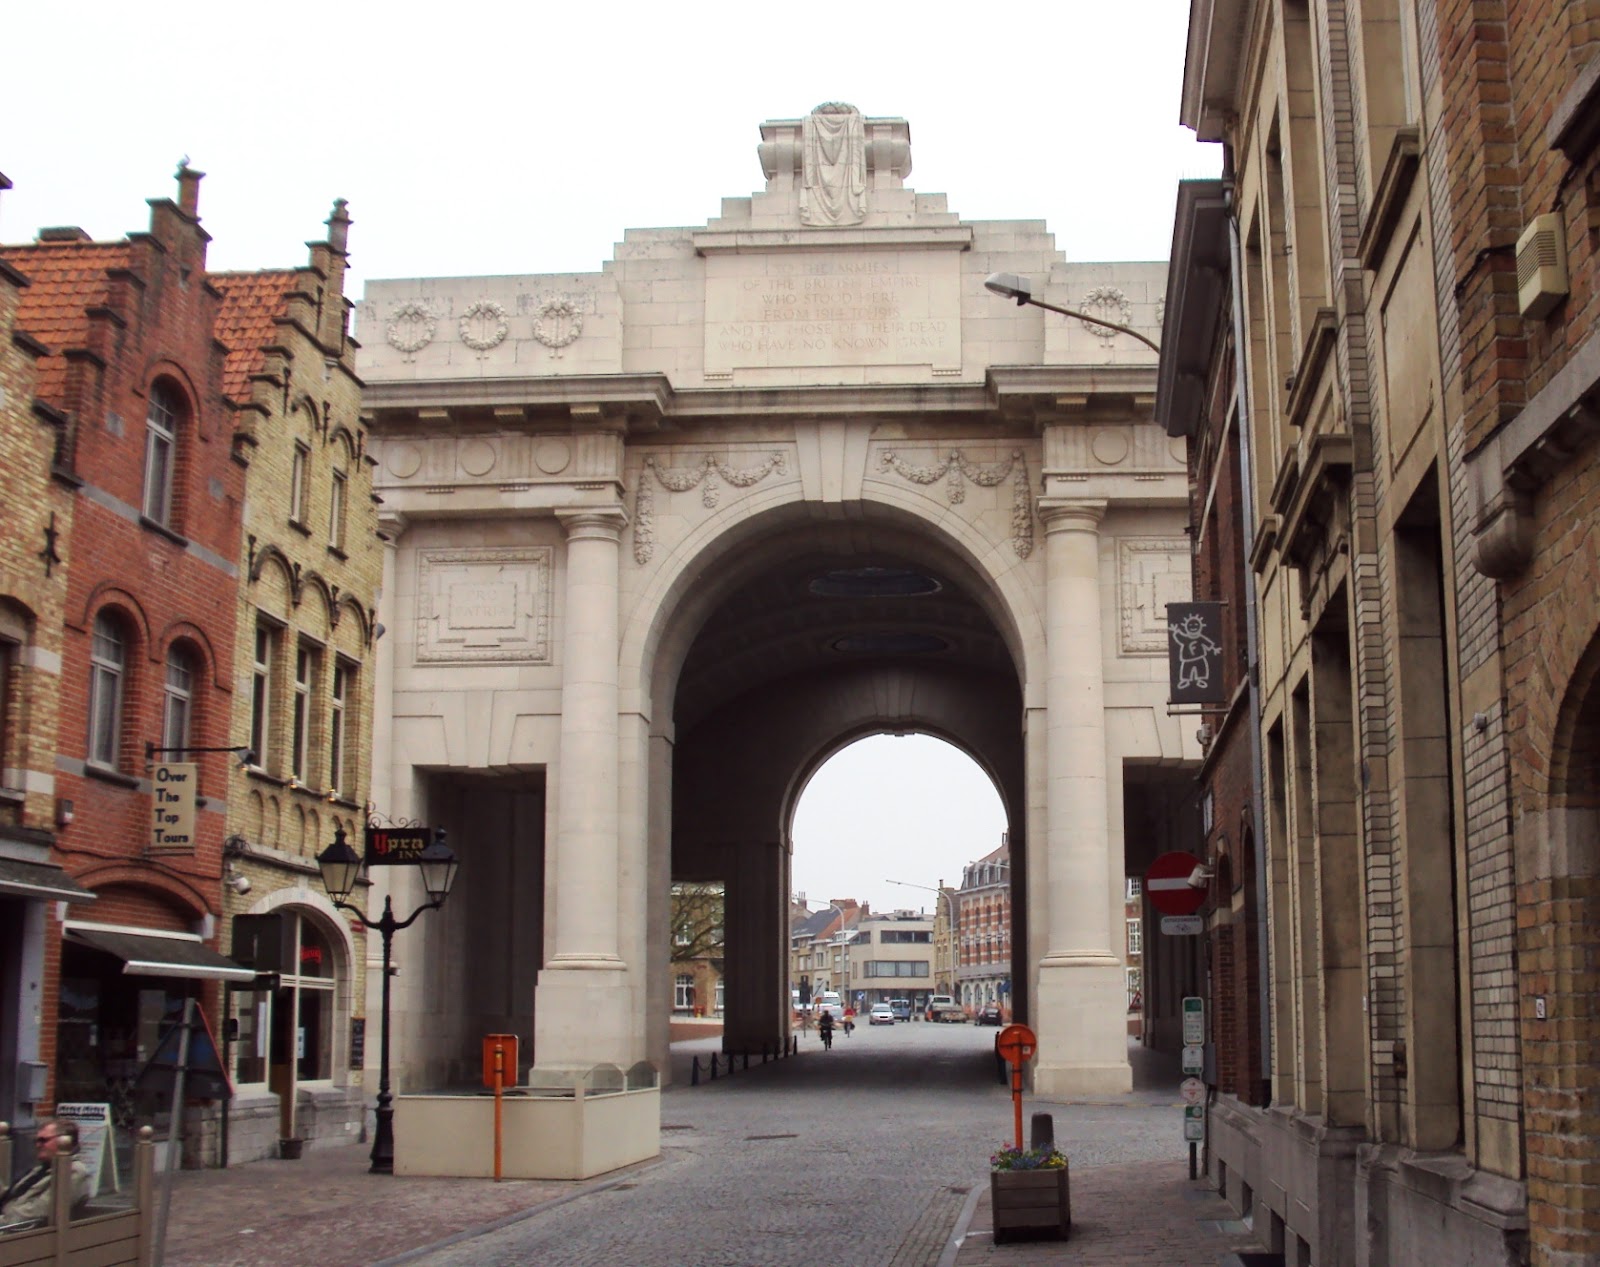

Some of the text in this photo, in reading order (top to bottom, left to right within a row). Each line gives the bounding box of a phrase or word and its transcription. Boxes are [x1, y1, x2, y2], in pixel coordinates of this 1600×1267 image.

[838, 262, 889, 273] ARMIES
[743, 276, 921, 291] OF THE BRIISH EMPIRE
[762, 294, 797, 305] WHO
[804, 293, 853, 304] STOOD
[764, 309, 809, 320] FROM
[720, 325, 753, 336] AND
[866, 322, 905, 333] THEIR
[911, 321, 947, 332] DEAD
[719, 341, 752, 352] WHO
[758, 339, 796, 351] HAVE
[803, 339, 826, 350] NO
[833, 337, 889, 349] KNOWN
[156, 767, 188, 783] Over
[155, 788, 180, 803] The
[154, 808, 180, 825] Top
[153, 828, 190, 844] Tours
